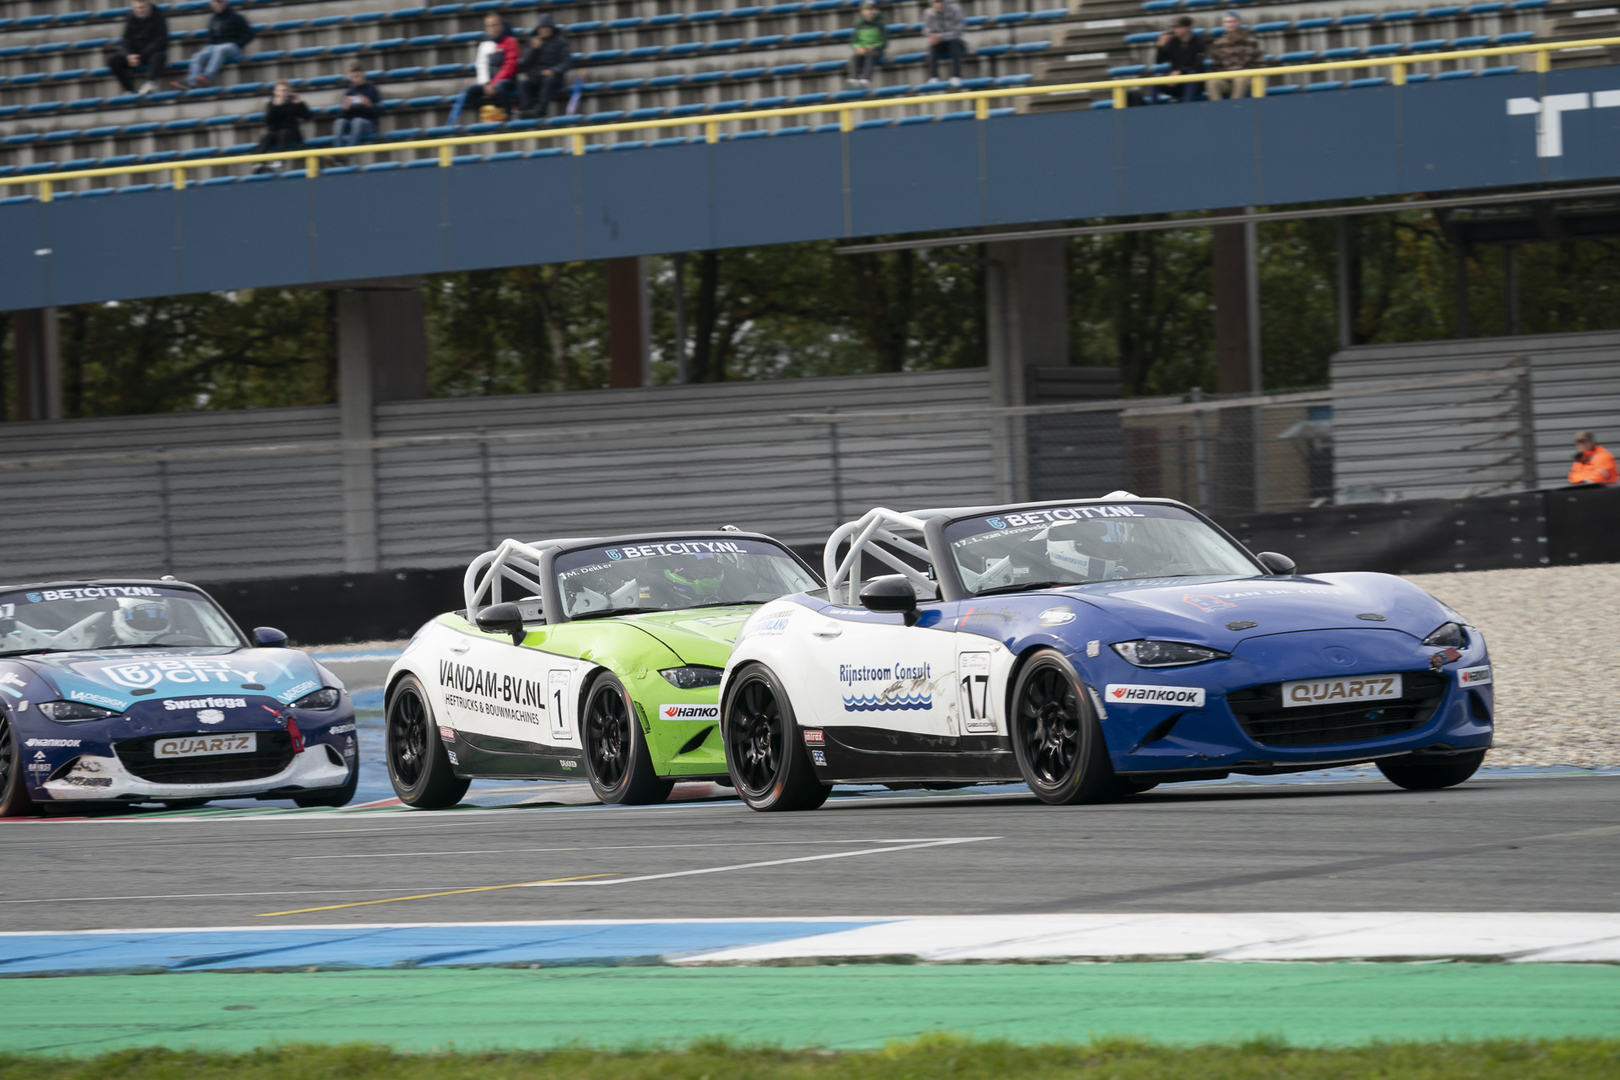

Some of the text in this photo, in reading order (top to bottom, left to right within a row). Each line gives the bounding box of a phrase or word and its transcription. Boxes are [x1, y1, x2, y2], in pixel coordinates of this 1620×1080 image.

[1004, 506, 1145, 527] BETCITY.NL
[984, 532, 1001, 541] van
[1002, 523, 1047, 536] Verseveld
[622, 542, 747, 558] BETCITY.NL
[582, 563, 612, 575] Dekker
[42, 587, 161, 601] BETCITY.NL
[156, 660, 232, 670] BET
[840, 661, 931, 687] Rijnstroom Consult
[163, 669, 259, 683] CITY
[440, 659, 546, 709] VANDAM-BV.NL
[961, 675, 989, 719] 17
[1290, 678, 1395, 702] QUARTZ
[163, 696, 247, 710] Swarfega
[445, 693, 539, 725] HEFTRUCKS & BOUWMACHINES
[554, 689, 564, 727] 1
[161, 737, 249, 755] QUARTZ
